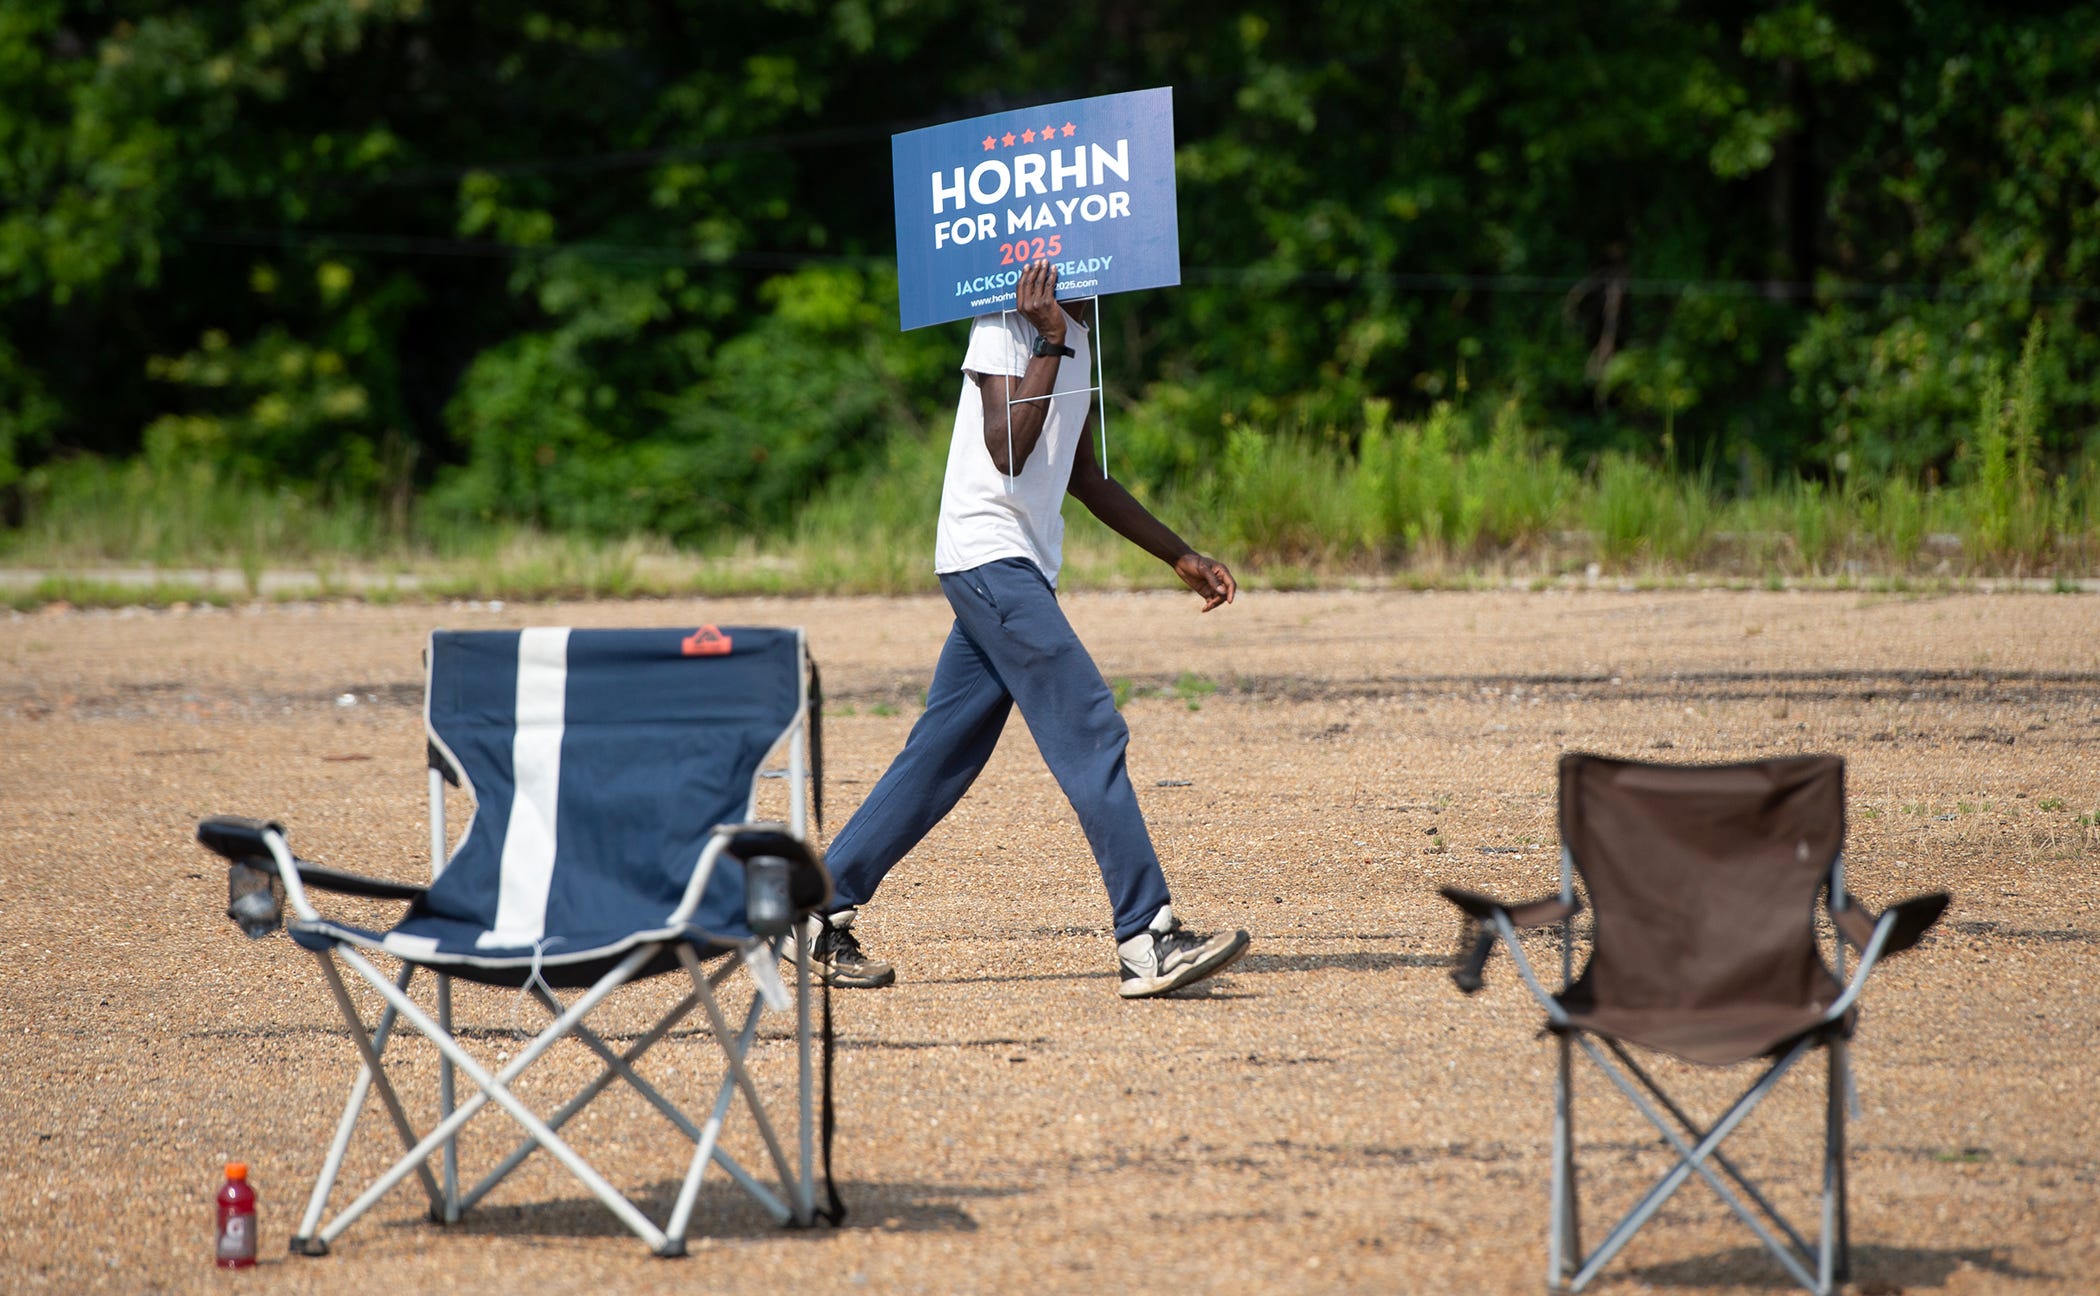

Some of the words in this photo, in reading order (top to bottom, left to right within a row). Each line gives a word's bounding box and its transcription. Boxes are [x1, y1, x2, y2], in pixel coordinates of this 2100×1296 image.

[931, 139, 1129, 214] HORHN
[934, 213, 997, 250] FOR
[1007, 191, 1131, 235] MAYOR
[999, 234, 1062, 265] 2025
[955, 270, 1022, 296] JACKSO
